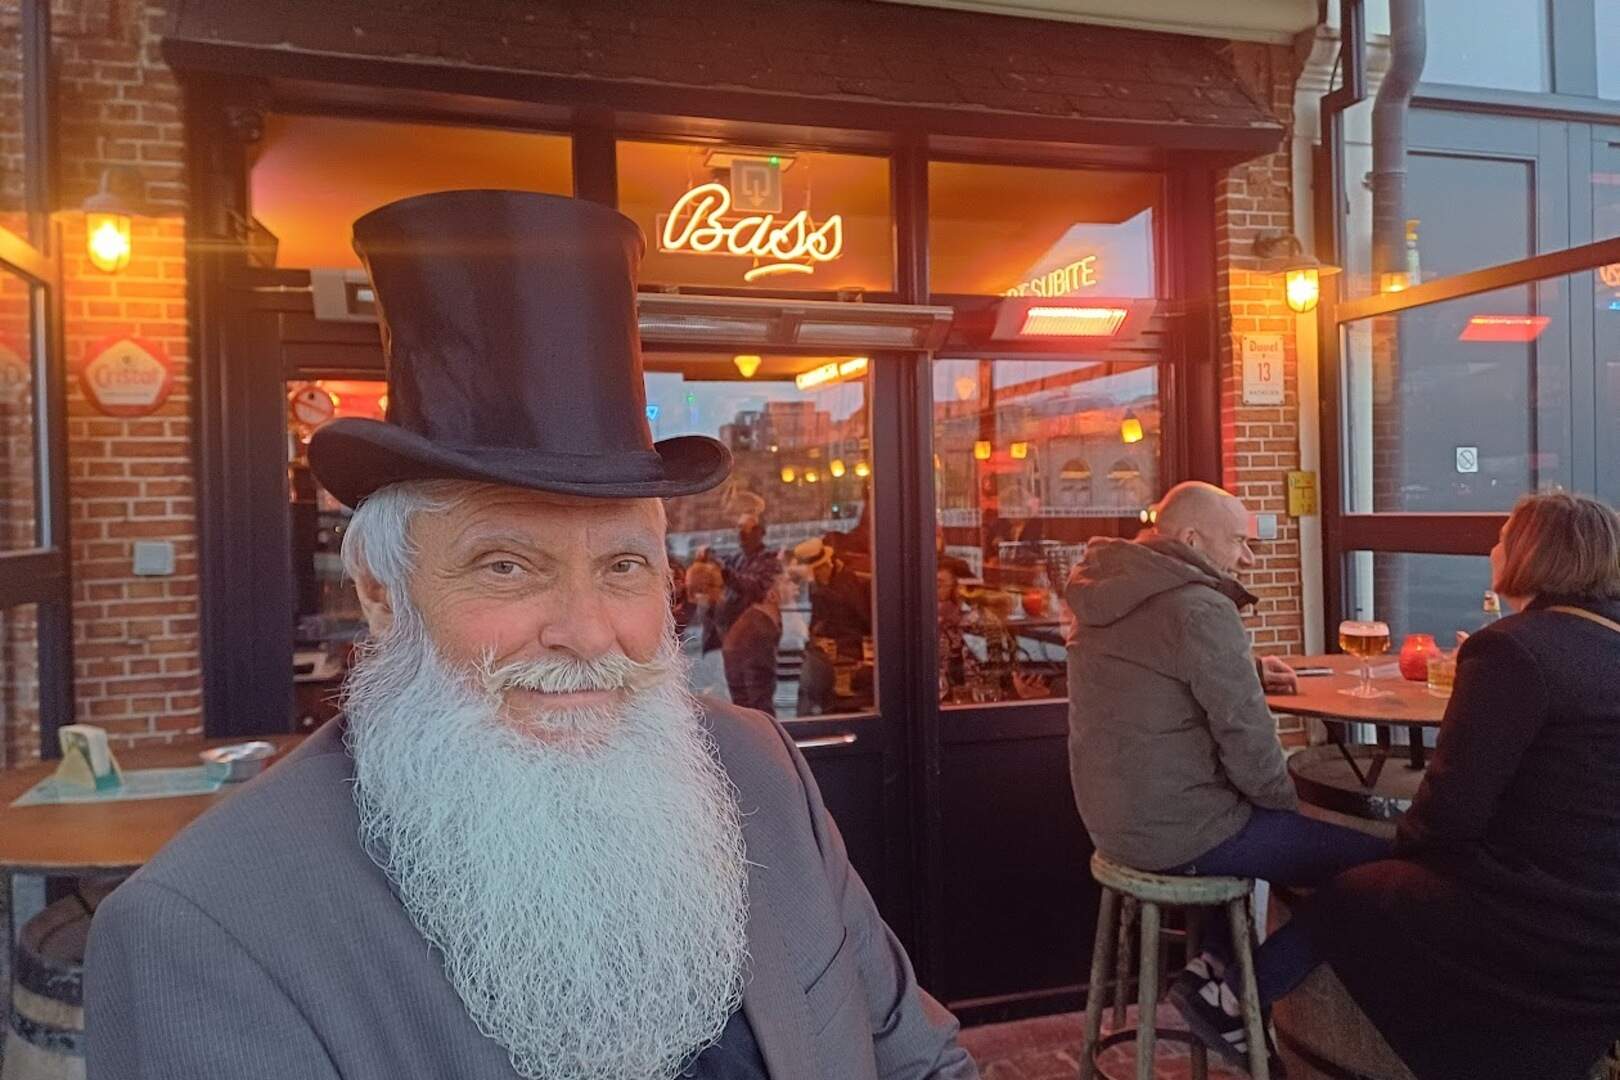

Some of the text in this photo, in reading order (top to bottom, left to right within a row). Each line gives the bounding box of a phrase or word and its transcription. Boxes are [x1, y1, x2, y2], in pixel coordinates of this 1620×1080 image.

[663, 183, 842, 261] Bass
[1031, 255, 1097, 298] SUBITE
[1249, 340, 1278, 352] Duvel
[1258, 361, 1271, 382] 13
